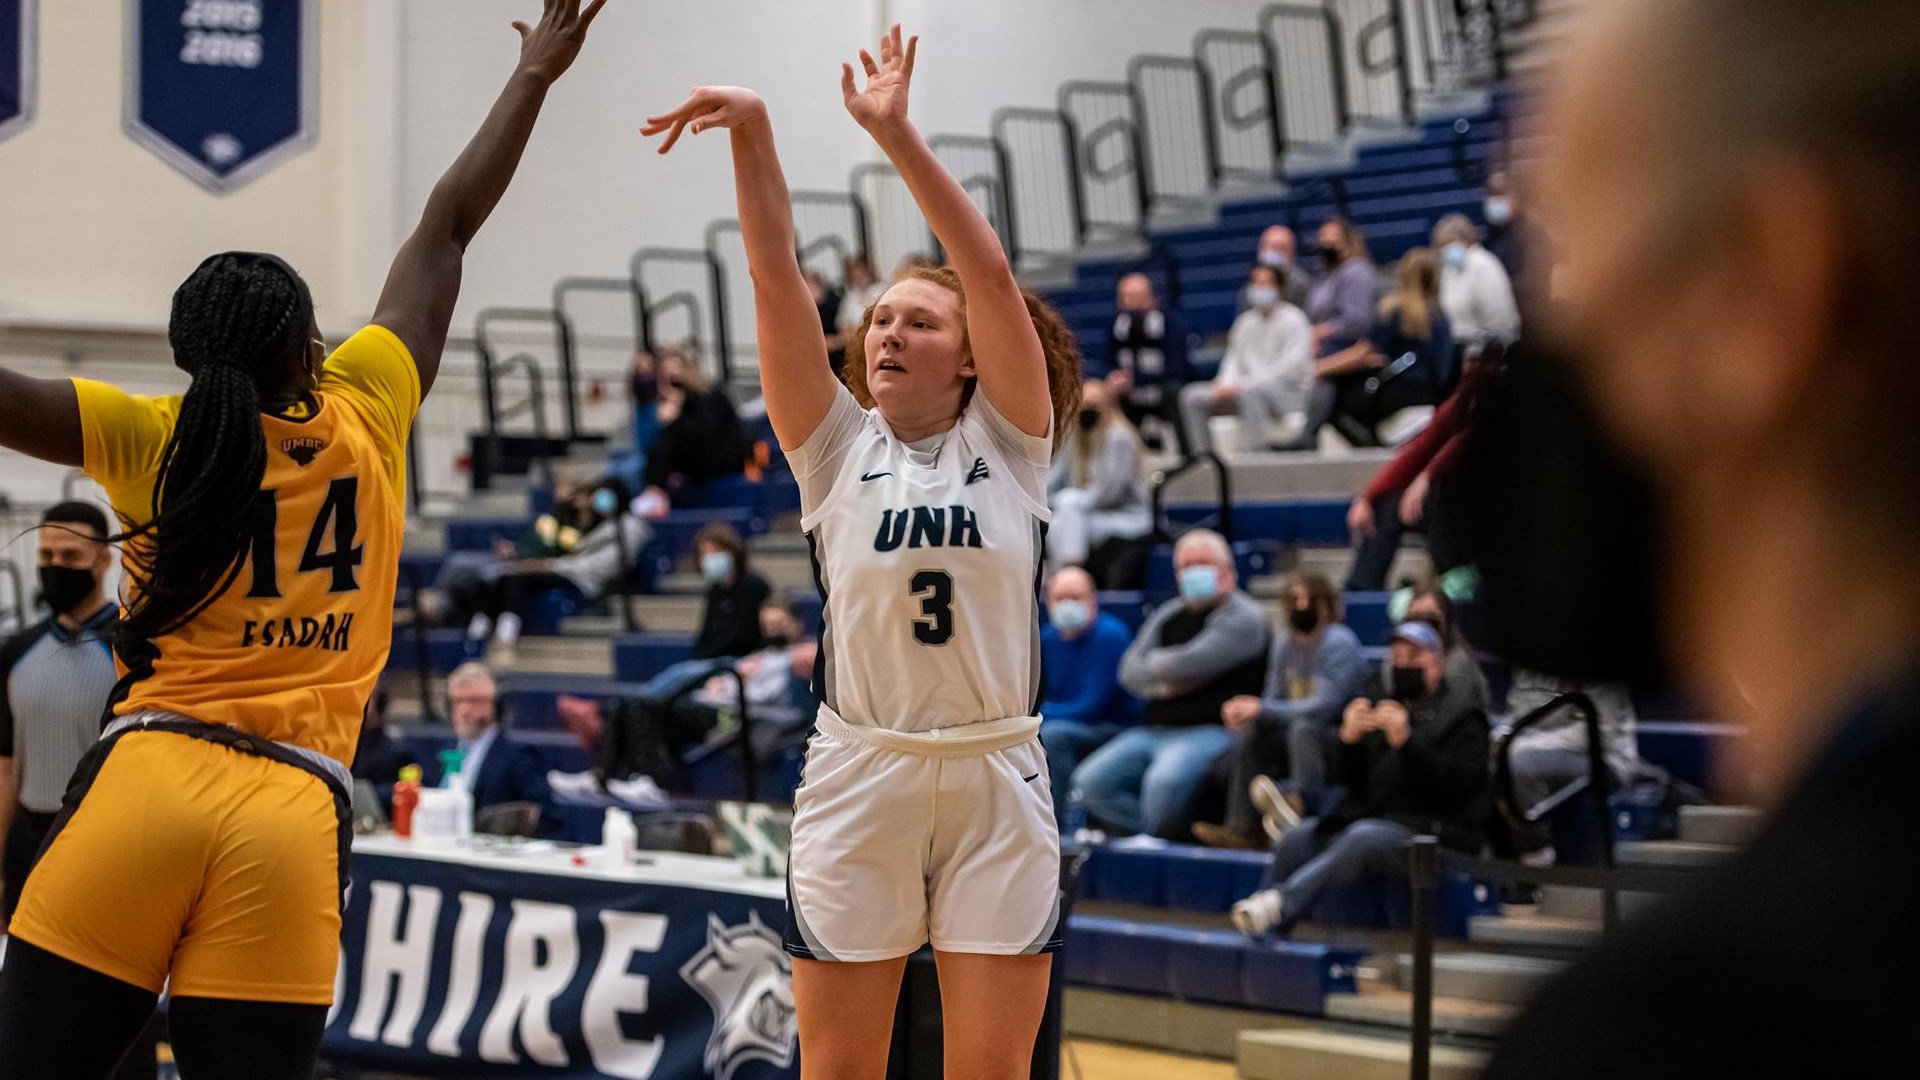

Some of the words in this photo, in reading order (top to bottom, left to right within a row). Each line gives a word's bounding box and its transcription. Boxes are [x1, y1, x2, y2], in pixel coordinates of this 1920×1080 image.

[179, 29, 264, 69] 2016
[281, 437, 324, 453] UMBC
[245, 476, 364, 599] 14
[874, 505, 983, 552] UNH
[908, 568, 955, 647] 3
[325, 876, 669, 1080] HIRE
